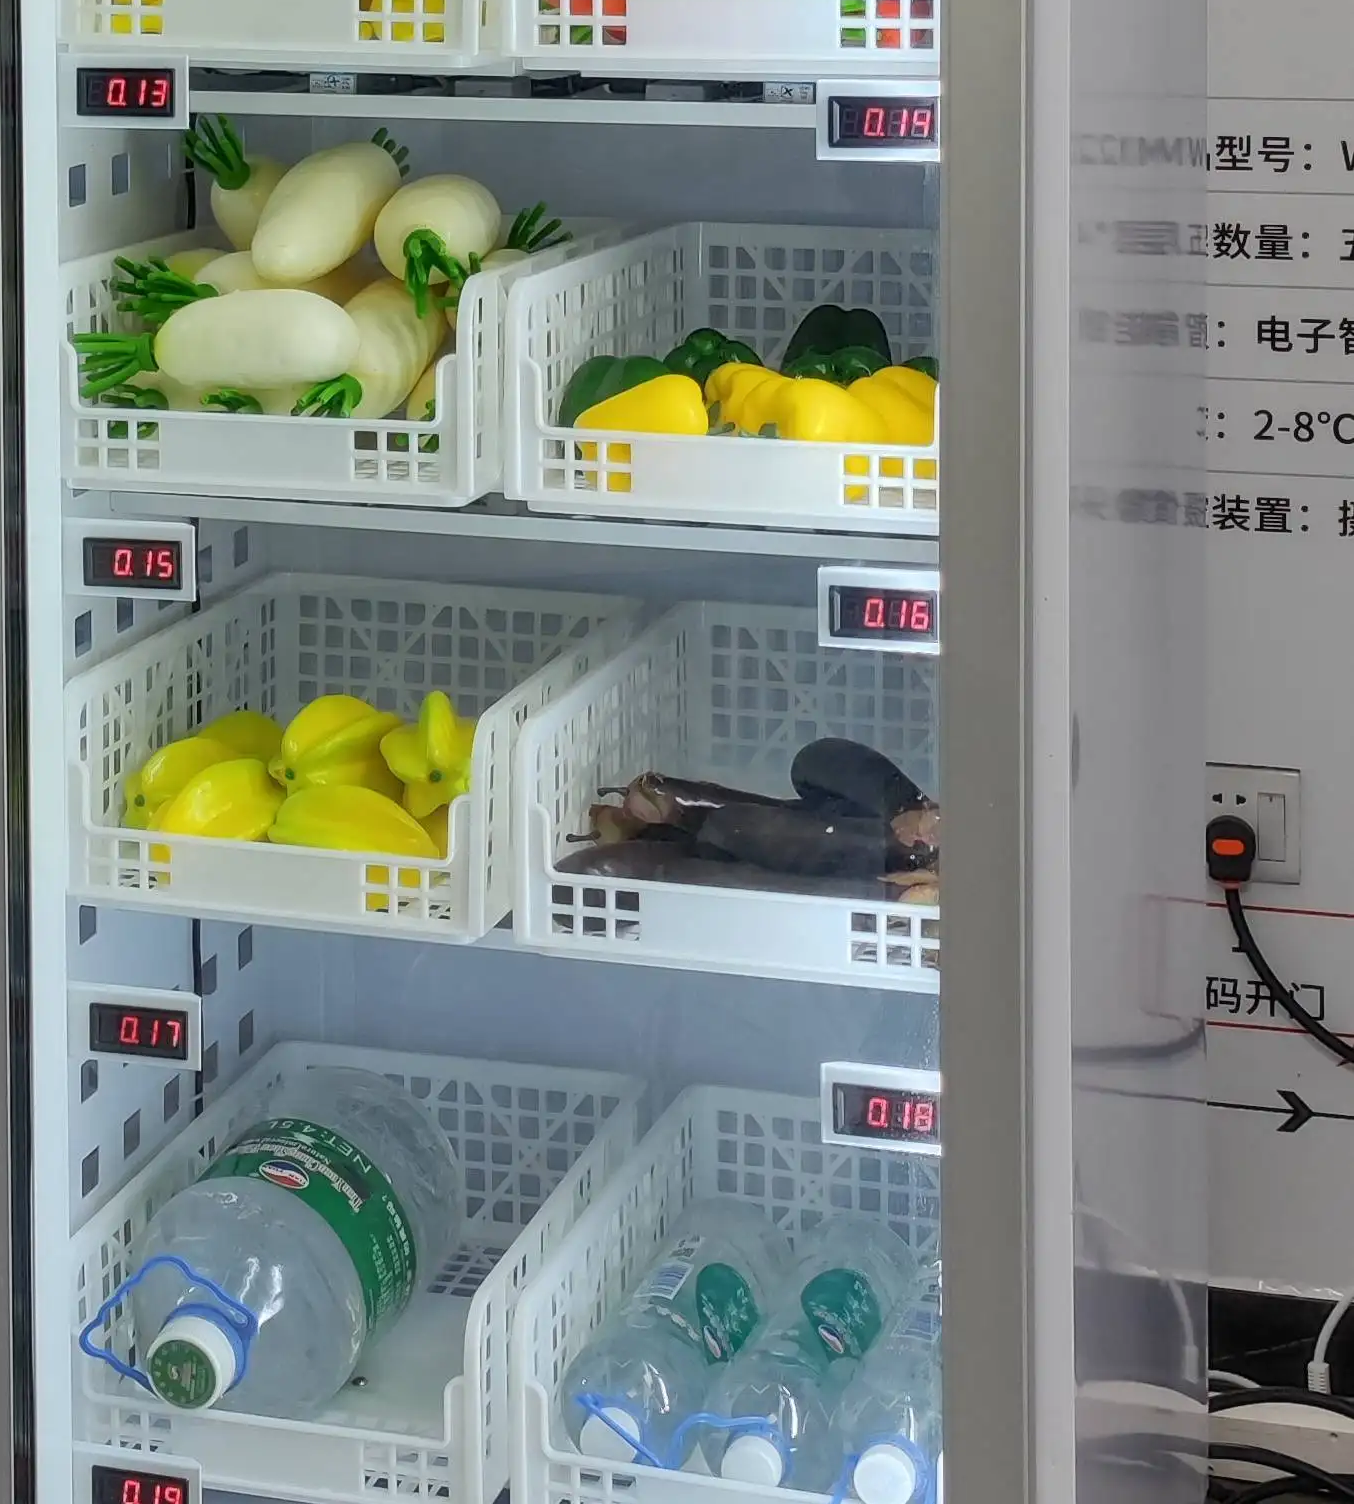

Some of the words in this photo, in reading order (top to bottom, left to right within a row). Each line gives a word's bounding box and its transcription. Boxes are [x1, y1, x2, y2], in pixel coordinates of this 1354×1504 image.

[105, 78, 167, 109] 0.13
[863, 108, 931, 138] 0.14
[112, 549, 174, 581] 0.15
[864, 598, 930, 630] 0.16
[119, 1015, 180, 1047] 0.17
[868, 1097, 934, 1132] 0.18
